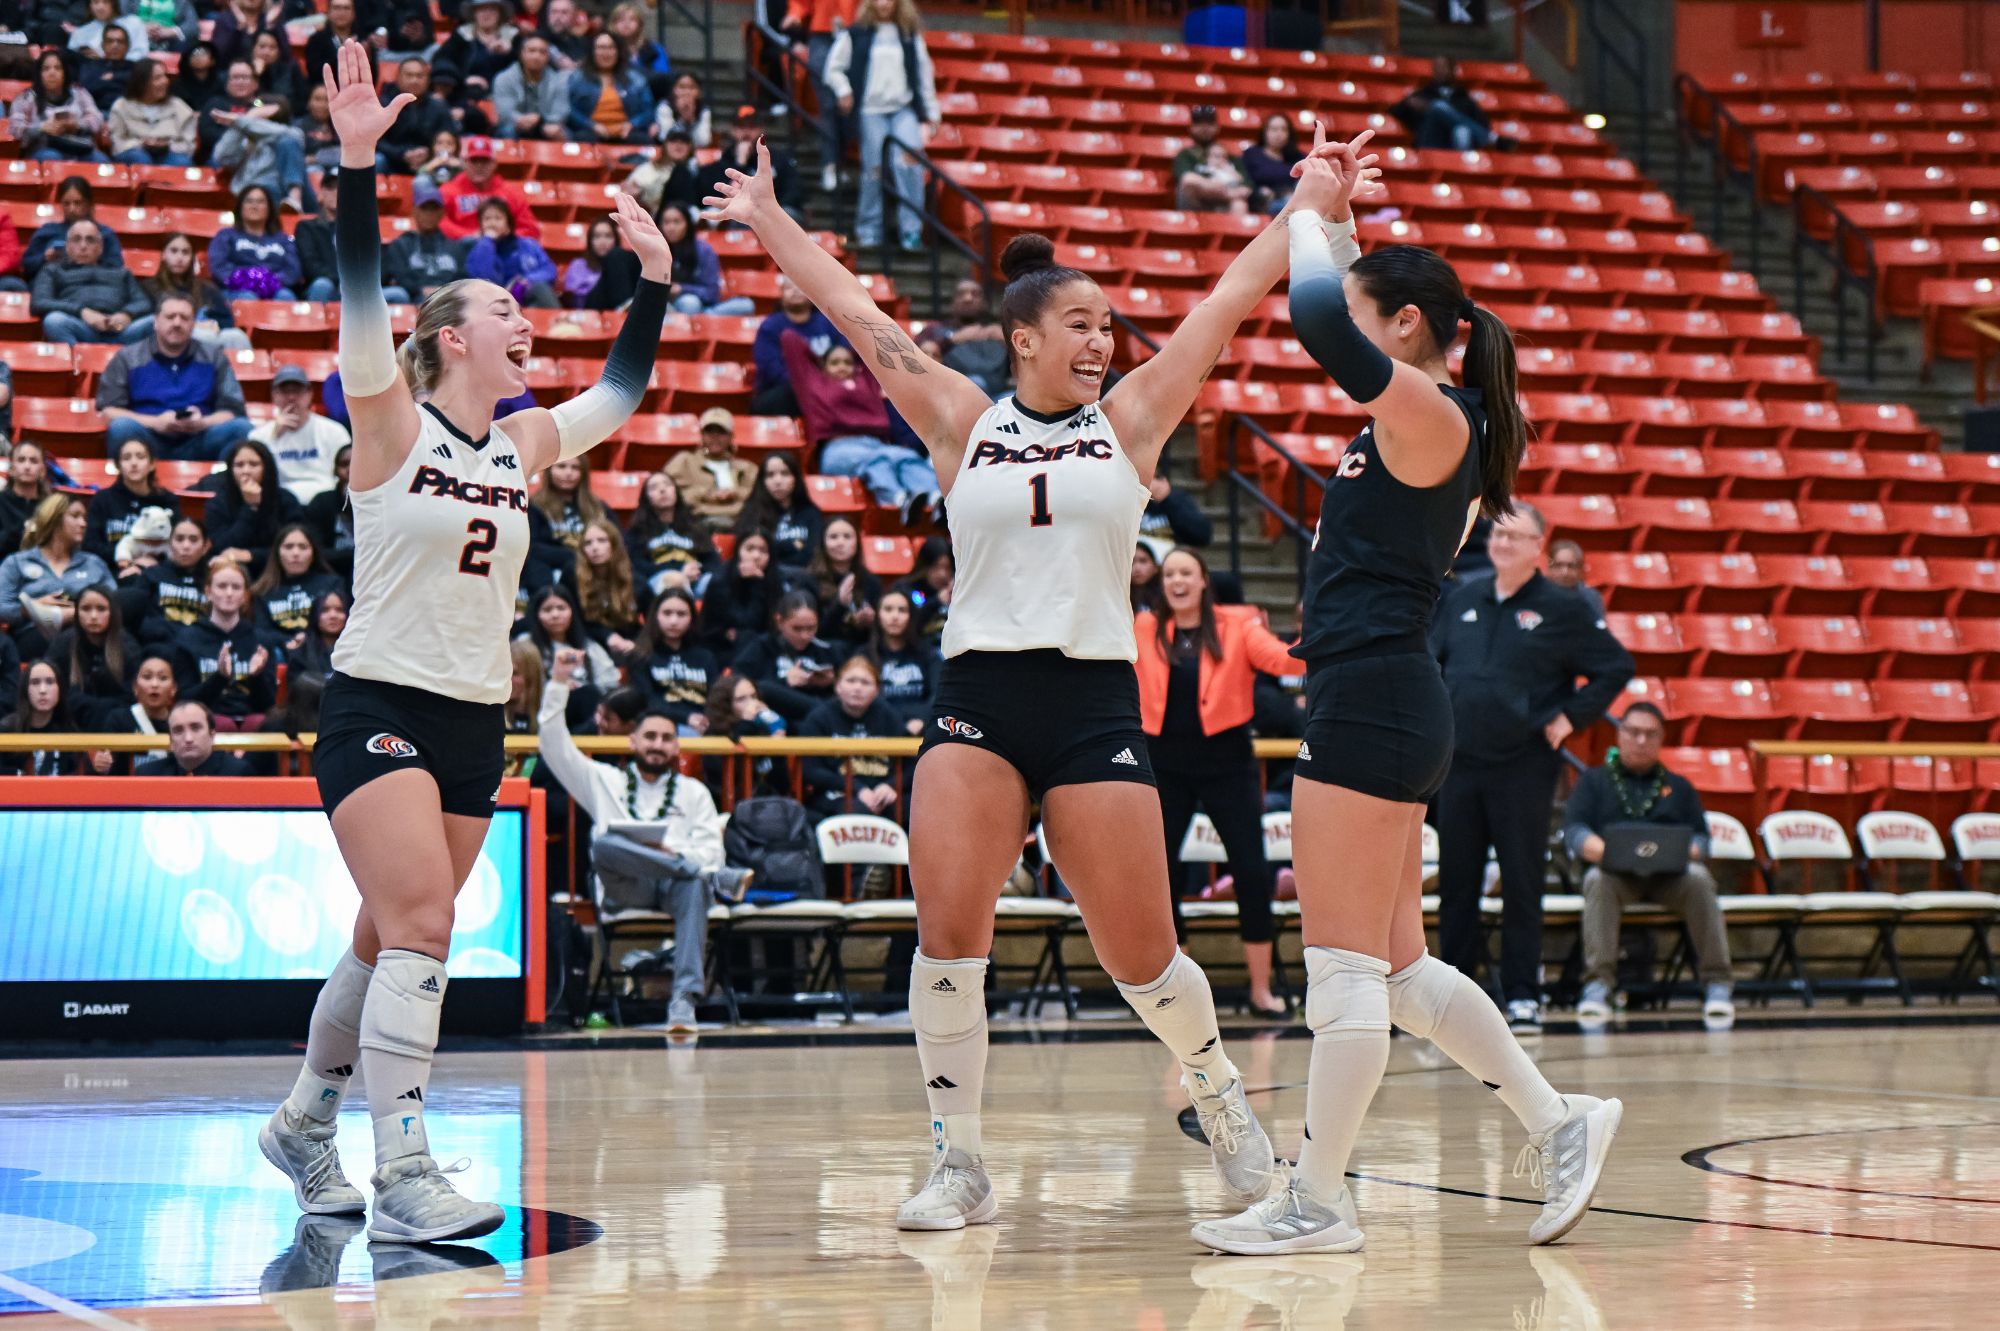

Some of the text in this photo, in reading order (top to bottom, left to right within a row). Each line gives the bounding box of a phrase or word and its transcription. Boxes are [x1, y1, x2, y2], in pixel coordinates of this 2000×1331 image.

[1760, 10, 1785, 37] L
[968, 438, 1113, 470] PACIFIC
[408, 464, 528, 514] PACIFIC
[1028, 472, 1052, 527] 1
[458, 517, 498, 577] 2
[1111, 757, 1138, 765] adidas
[827, 825, 900, 848] PACIFIC
[419, 984, 440, 993] adidas
[82, 1003, 130, 1015] ADART
